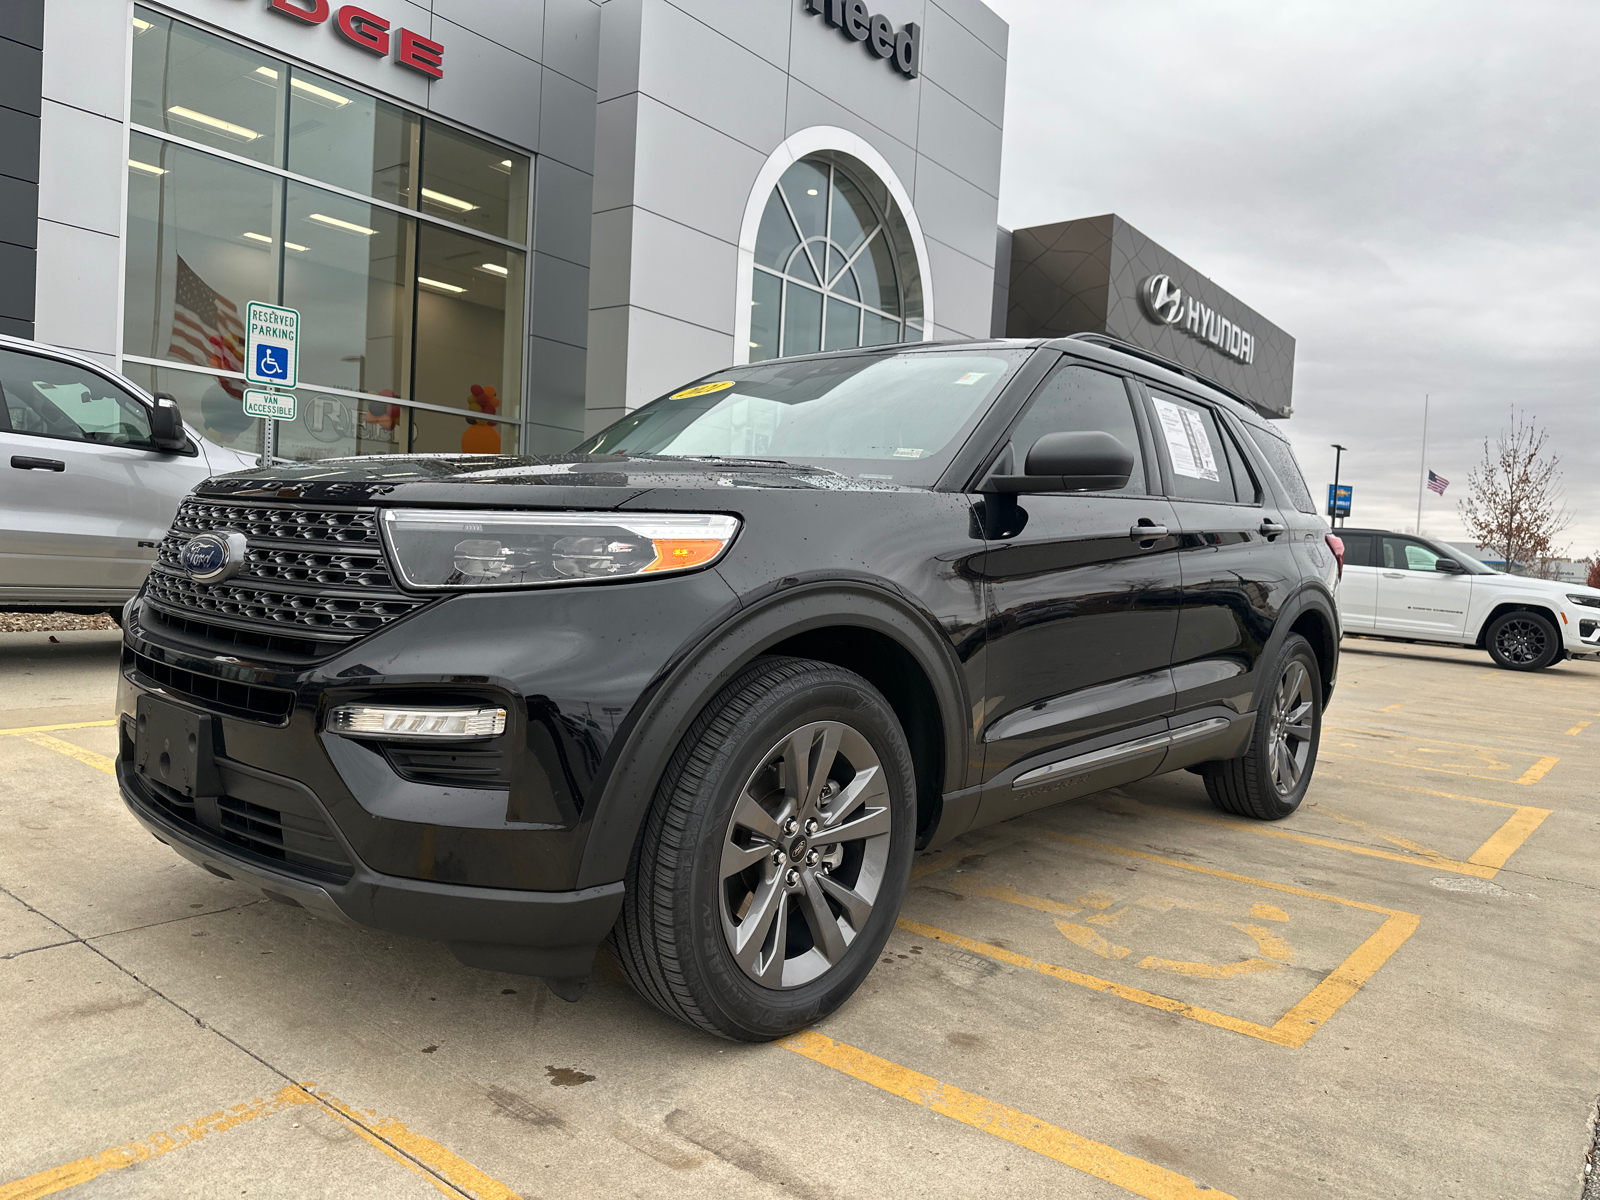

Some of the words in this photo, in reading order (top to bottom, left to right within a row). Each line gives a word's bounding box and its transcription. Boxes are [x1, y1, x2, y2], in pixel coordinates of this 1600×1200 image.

[252, 309, 295, 328] RESERVED
[251, 323, 295, 341] PARKING
[1185, 295, 1255, 365] HYUNDAI
[263, 395, 278, 405] VAN
[248, 403, 293, 416] ACCESSIBLE
[884, 722, 915, 809] YOKOHAMA
